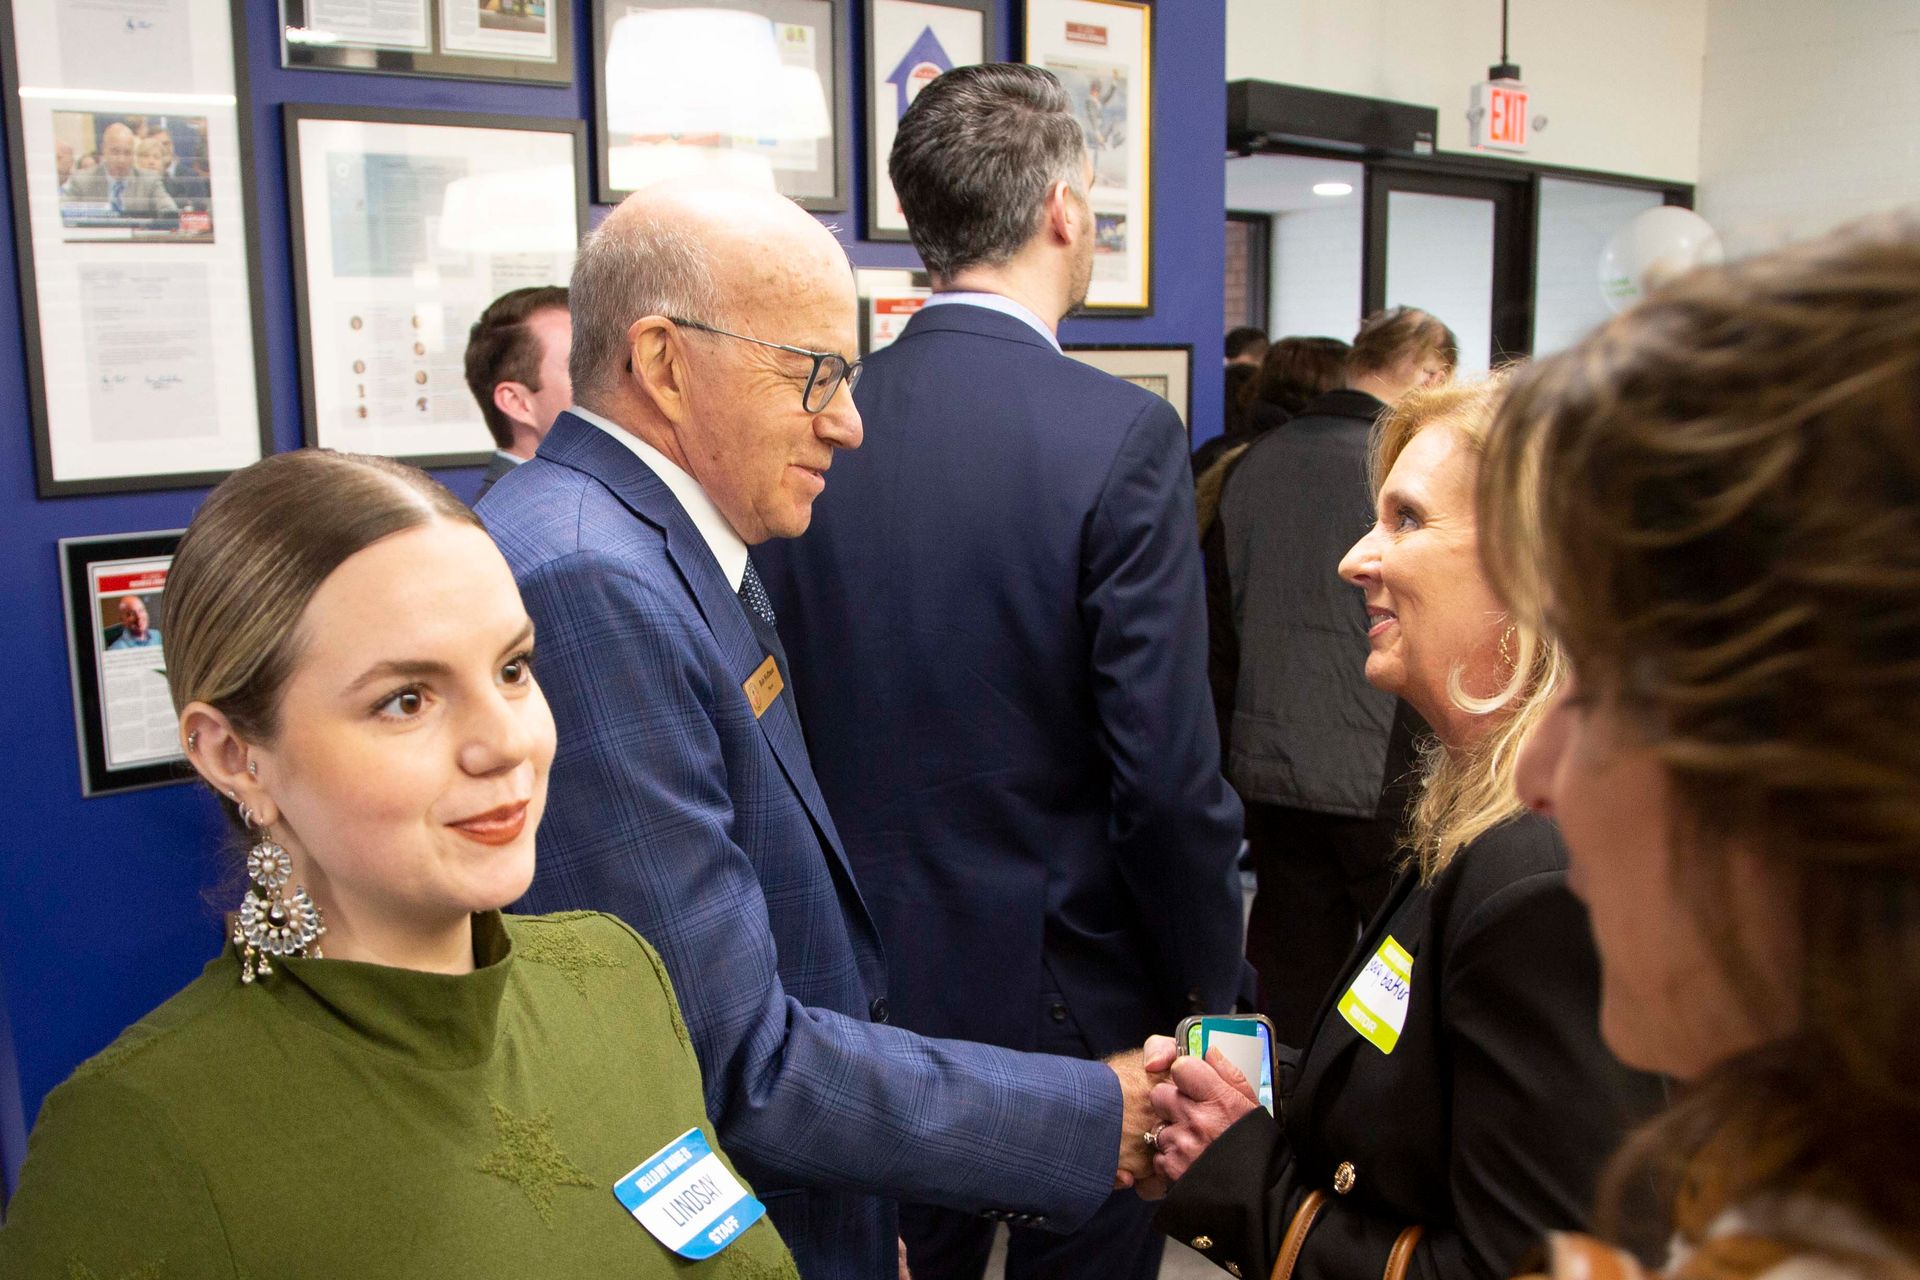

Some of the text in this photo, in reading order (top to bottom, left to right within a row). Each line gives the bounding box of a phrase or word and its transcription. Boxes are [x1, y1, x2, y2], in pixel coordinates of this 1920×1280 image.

[1490, 88, 1528, 145] EXIT
[661, 1173, 724, 1228] LINDSAY
[708, 1214, 740, 1245] STAFF
